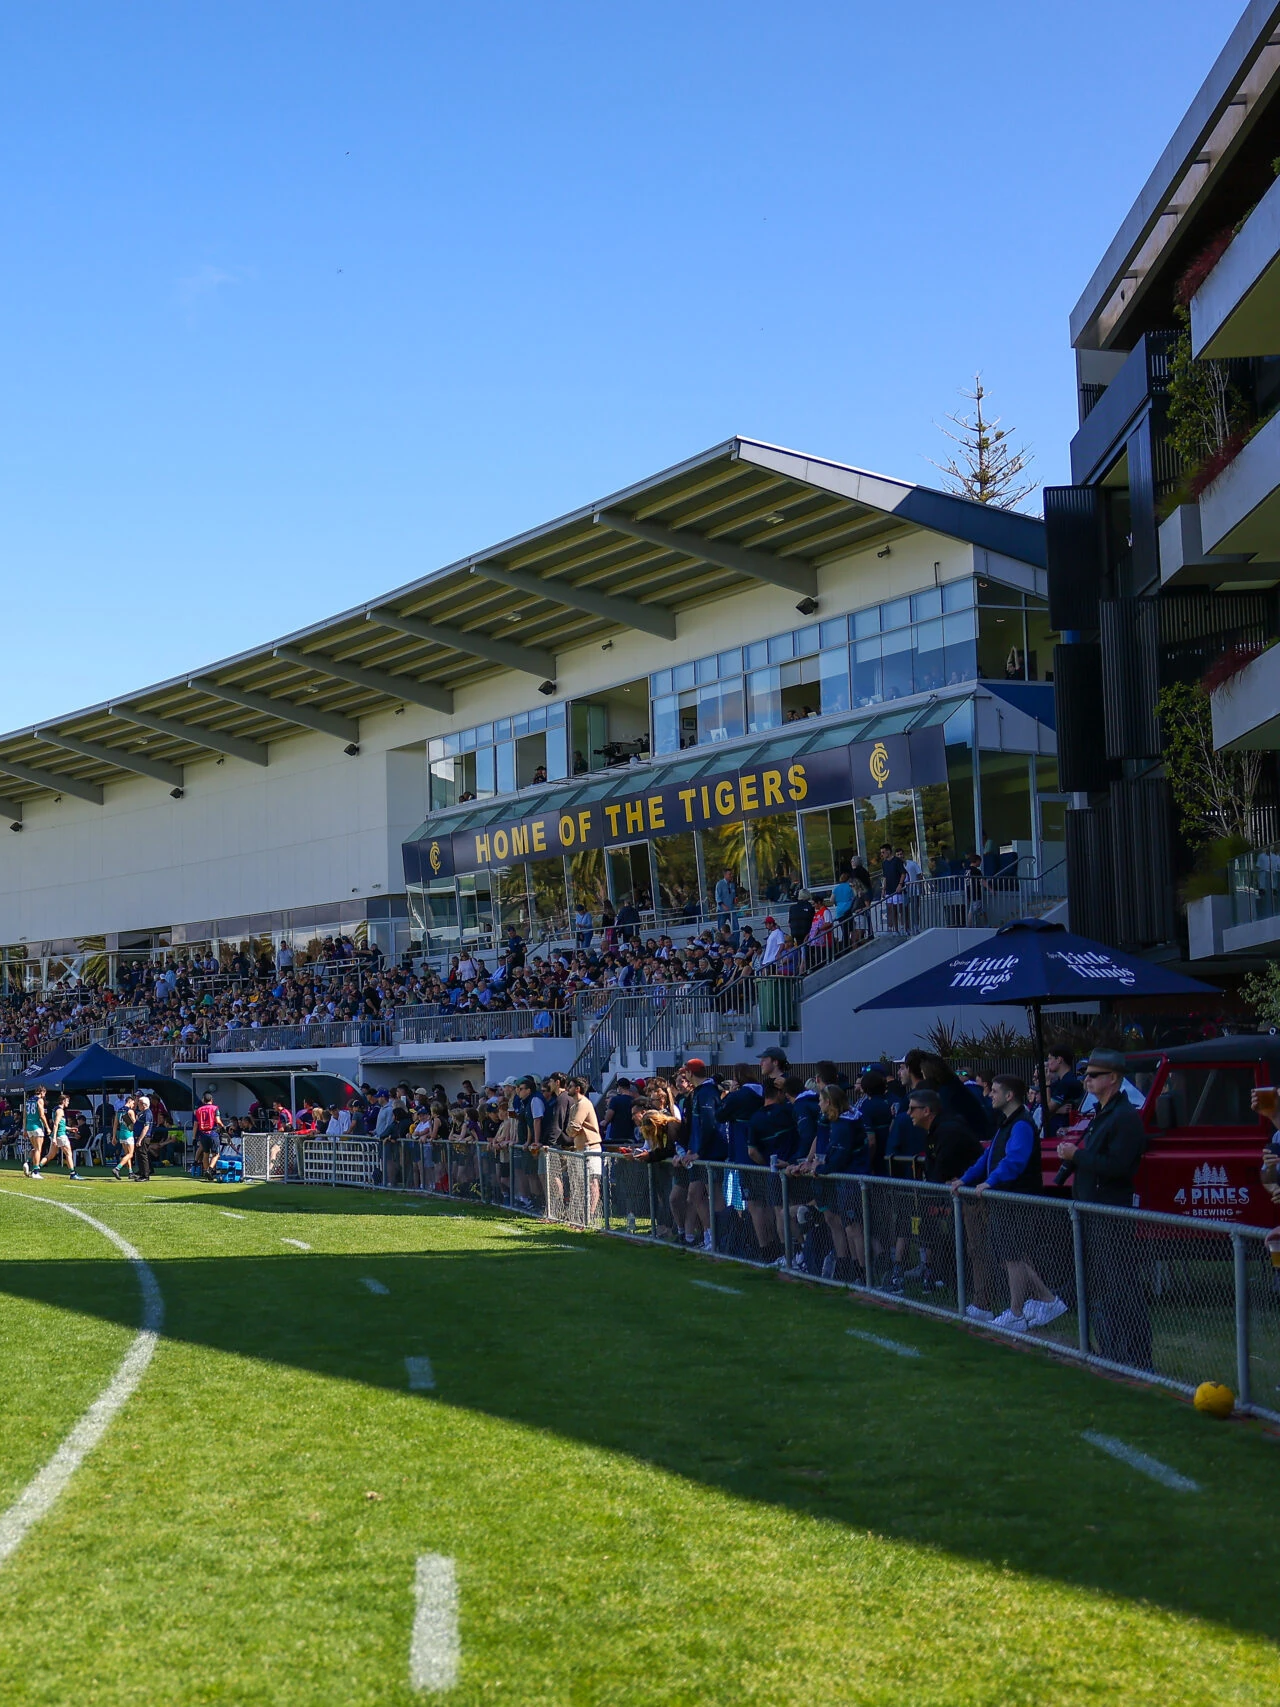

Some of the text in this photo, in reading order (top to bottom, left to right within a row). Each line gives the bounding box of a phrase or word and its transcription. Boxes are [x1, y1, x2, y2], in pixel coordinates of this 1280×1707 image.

[475, 764, 808, 864] HOME OF THE TIGERS
[965, 955, 1019, 972] Little
[1057, 951, 1112, 965] Little
[949, 969, 1014, 994] Things
[1067, 964, 1135, 987] Things
[26, 1102, 36, 1115] 38
[1174, 1187, 1250, 1205] 4 PINES
[1192, 1208, 1234, 1216] BREWING
